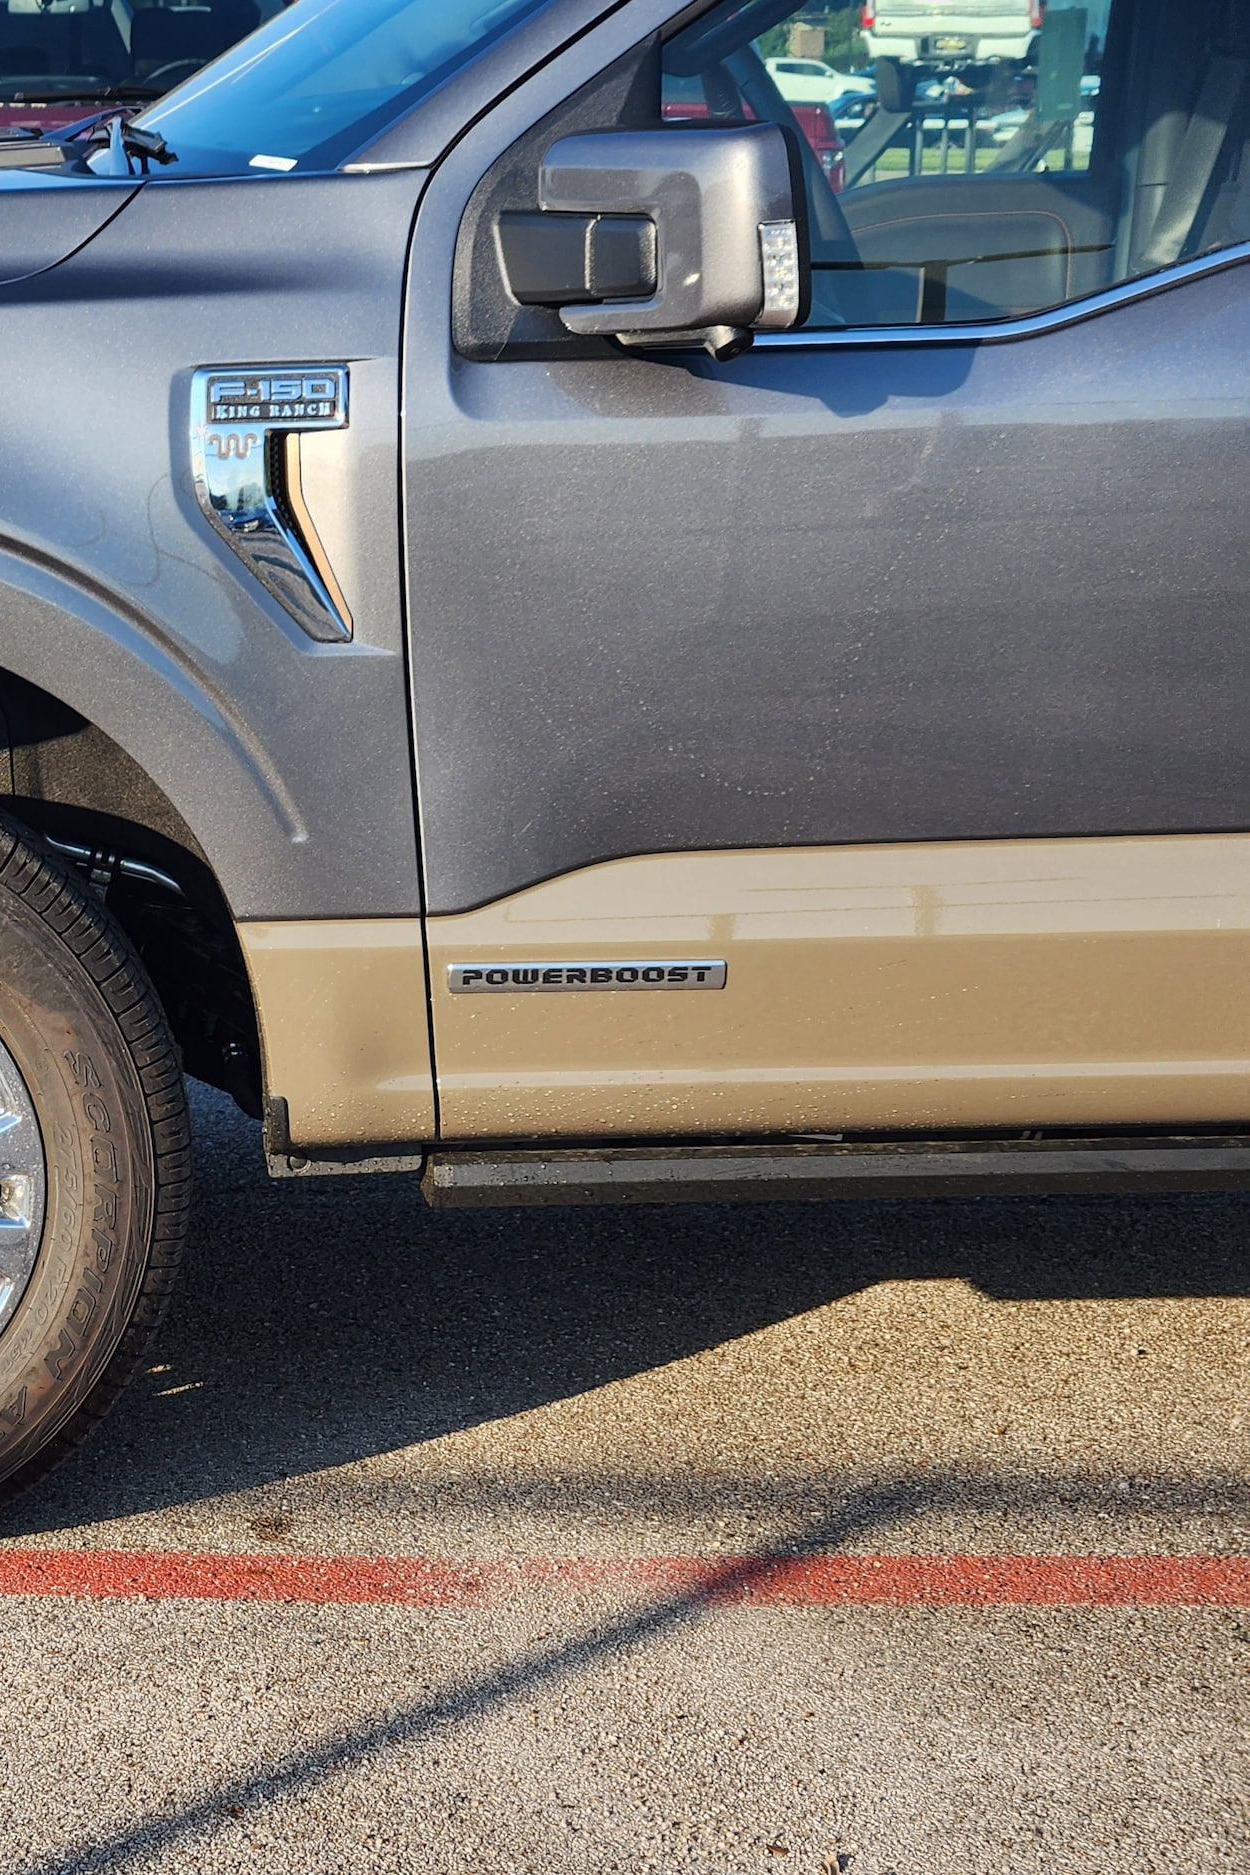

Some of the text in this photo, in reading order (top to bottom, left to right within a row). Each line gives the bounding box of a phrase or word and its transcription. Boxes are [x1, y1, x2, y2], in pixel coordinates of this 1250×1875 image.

[211, 378, 336, 403] F-150
[216, 401, 331, 420] KING RANCH
[462, 965, 693, 986] POWERBOOST
[53, 1121, 79, 1253] 275/60
[45, 1050, 120, 1380] SCORPION
[30, 1256, 69, 1328] R20
